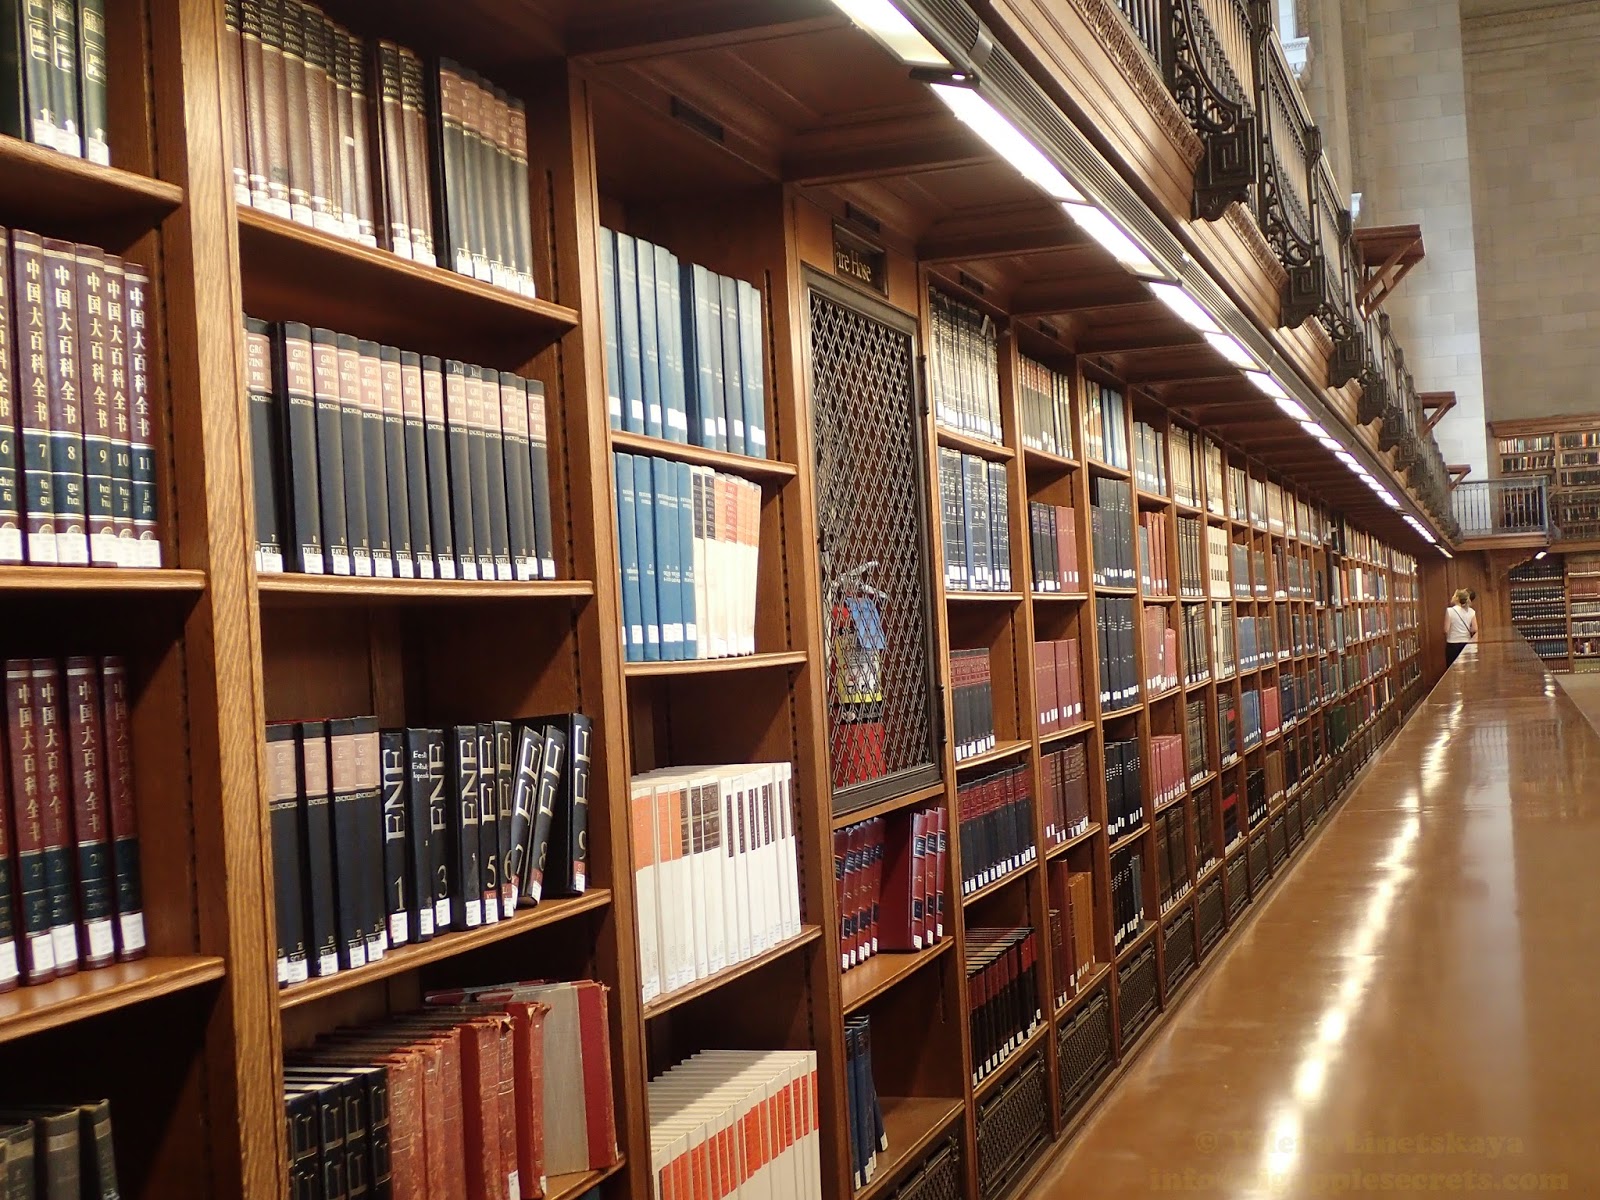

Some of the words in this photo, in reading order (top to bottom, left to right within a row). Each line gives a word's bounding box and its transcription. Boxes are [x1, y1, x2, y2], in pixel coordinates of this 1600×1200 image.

[835, 242, 850, 272] ire
[26, 258, 47, 422] 中国大百科全书
[55, 265, 76, 424] 中国大百科全书
[87, 272, 107, 429] 中国大百科全书
[107, 280, 127, 432] 中国大百科全书
[130, 287, 150, 437] 中国大百科全书
[1, 440, 9, 454] 6
[38, 444, 48, 458] 7
[68, 446, 76, 460] 8
[100, 449, 107, 463] 9
[117, 453, 129, 467] 10
[139, 456, 150, 470] 11
[40, 496, 51, 506] gu
[67, 483, 79, 493] gu
[119, 486, 129, 496] hu
[78, 680, 101, 833] 中国大百科全书
[382, 745, 406, 844] ENE
[429, 741, 447, 835] ENE
[460, 737, 479, 829] ENE
[487, 855, 496, 889] 5
[504, 850, 512, 881] 6
[514, 844, 525, 875] 7
[539, 841, 548, 872] 8
[394, 876, 406, 912] 1
[437, 864, 448, 899] 3
